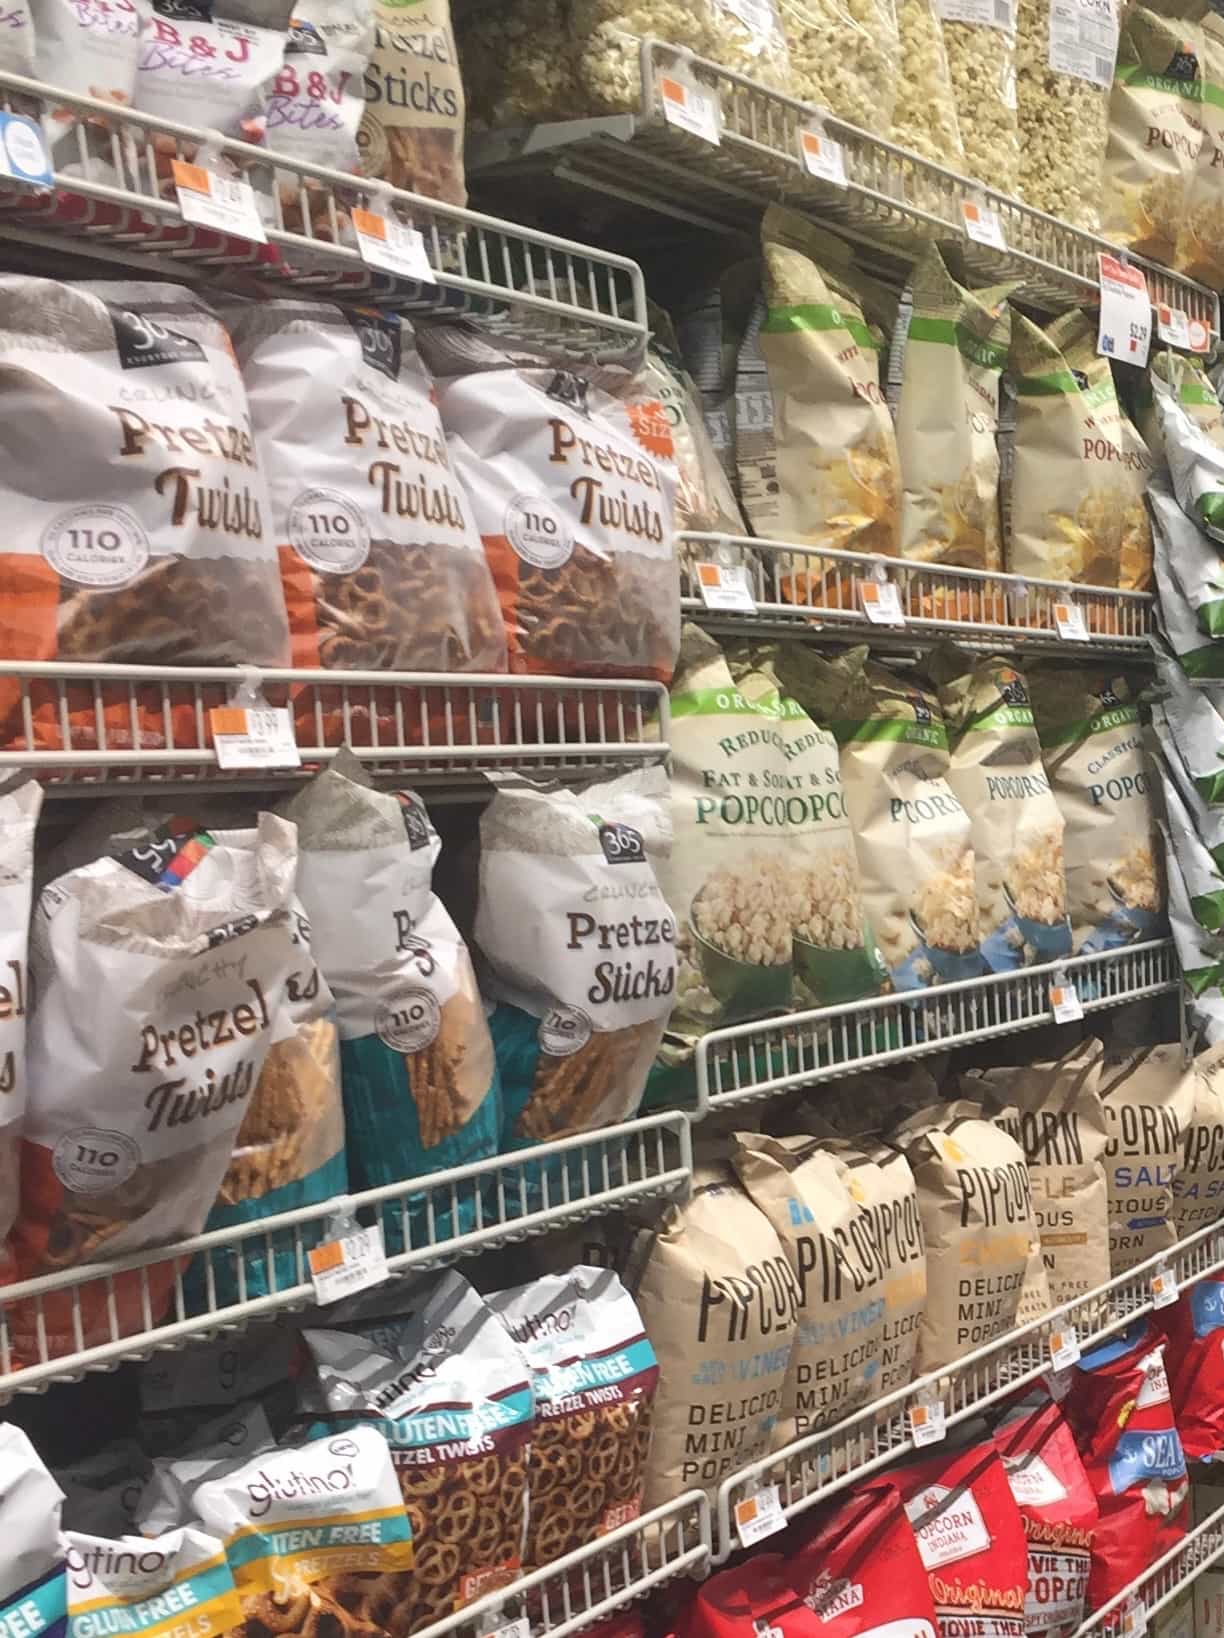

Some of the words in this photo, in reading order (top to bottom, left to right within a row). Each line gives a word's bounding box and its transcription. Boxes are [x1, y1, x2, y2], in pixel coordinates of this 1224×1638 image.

[151, 17, 182, 47] B
[189, 36, 216, 59] &
[226, 37, 250, 63] J
[272, 64, 300, 98] B
[307, 71, 327, 101] &
[363, 62, 458, 118] Sticks
[1146, 76, 1202, 98] ORGANI
[107, 405, 258, 469] Pretze
[549, 418, 661, 490] Pretzel
[154, 466, 264, 540] Twists
[368, 461, 466, 531] Twists
[570, 476, 664, 543] Twists
[66, 529, 121, 552] 110
[308, 514, 351, 535] 110
[521, 512, 557, 535] 110
[718, 729, 785, 758] REDUC
[695, 794, 786, 826] POPCO
[605, 828, 641, 855] 365
[566, 911, 674, 950] Pretze
[587, 958, 674, 1005] Sticks
[131, 979, 271, 1074] Pretzel
[391, 1004, 425, 1028] 110
[144, 1060, 257, 1133] Twists
[75, 1144, 119, 1168] 110
[957, 1160, 1033, 1228] PIPCOR
[1114, 1163, 1177, 1189] SALT
[587, 1385, 625, 1407] TWISTS
[687, 1389, 782, 1426] DELICIO
[796, 1382, 850, 1409] MINI
[392, 1408, 457, 1444] LUTEN
[684, 1429, 746, 1454] MINI
[393, 1449, 435, 1466] TZEL
[1142, 1433, 1178, 1469] SEA
[327, 1530, 382, 1547] FREE
[0, 1598, 47, 1638] REE
[135, 1582, 200, 1626] FREE
